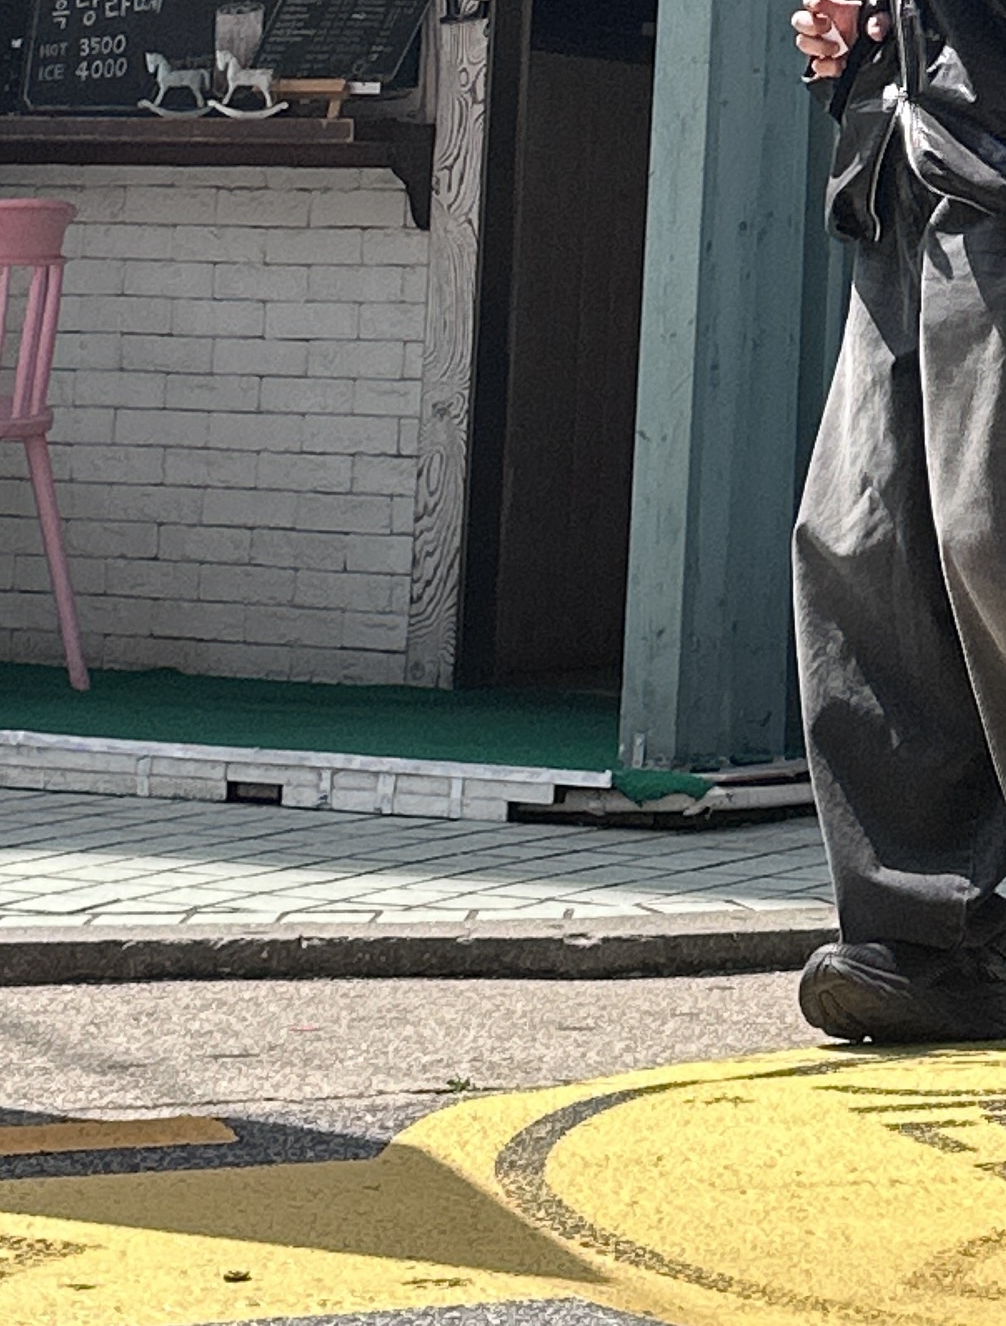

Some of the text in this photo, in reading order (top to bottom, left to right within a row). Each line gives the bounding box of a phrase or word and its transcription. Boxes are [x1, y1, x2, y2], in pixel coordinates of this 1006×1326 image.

[39, 34, 126, 59] HOT 3500
[38, 57, 128, 82] ICE 4000
